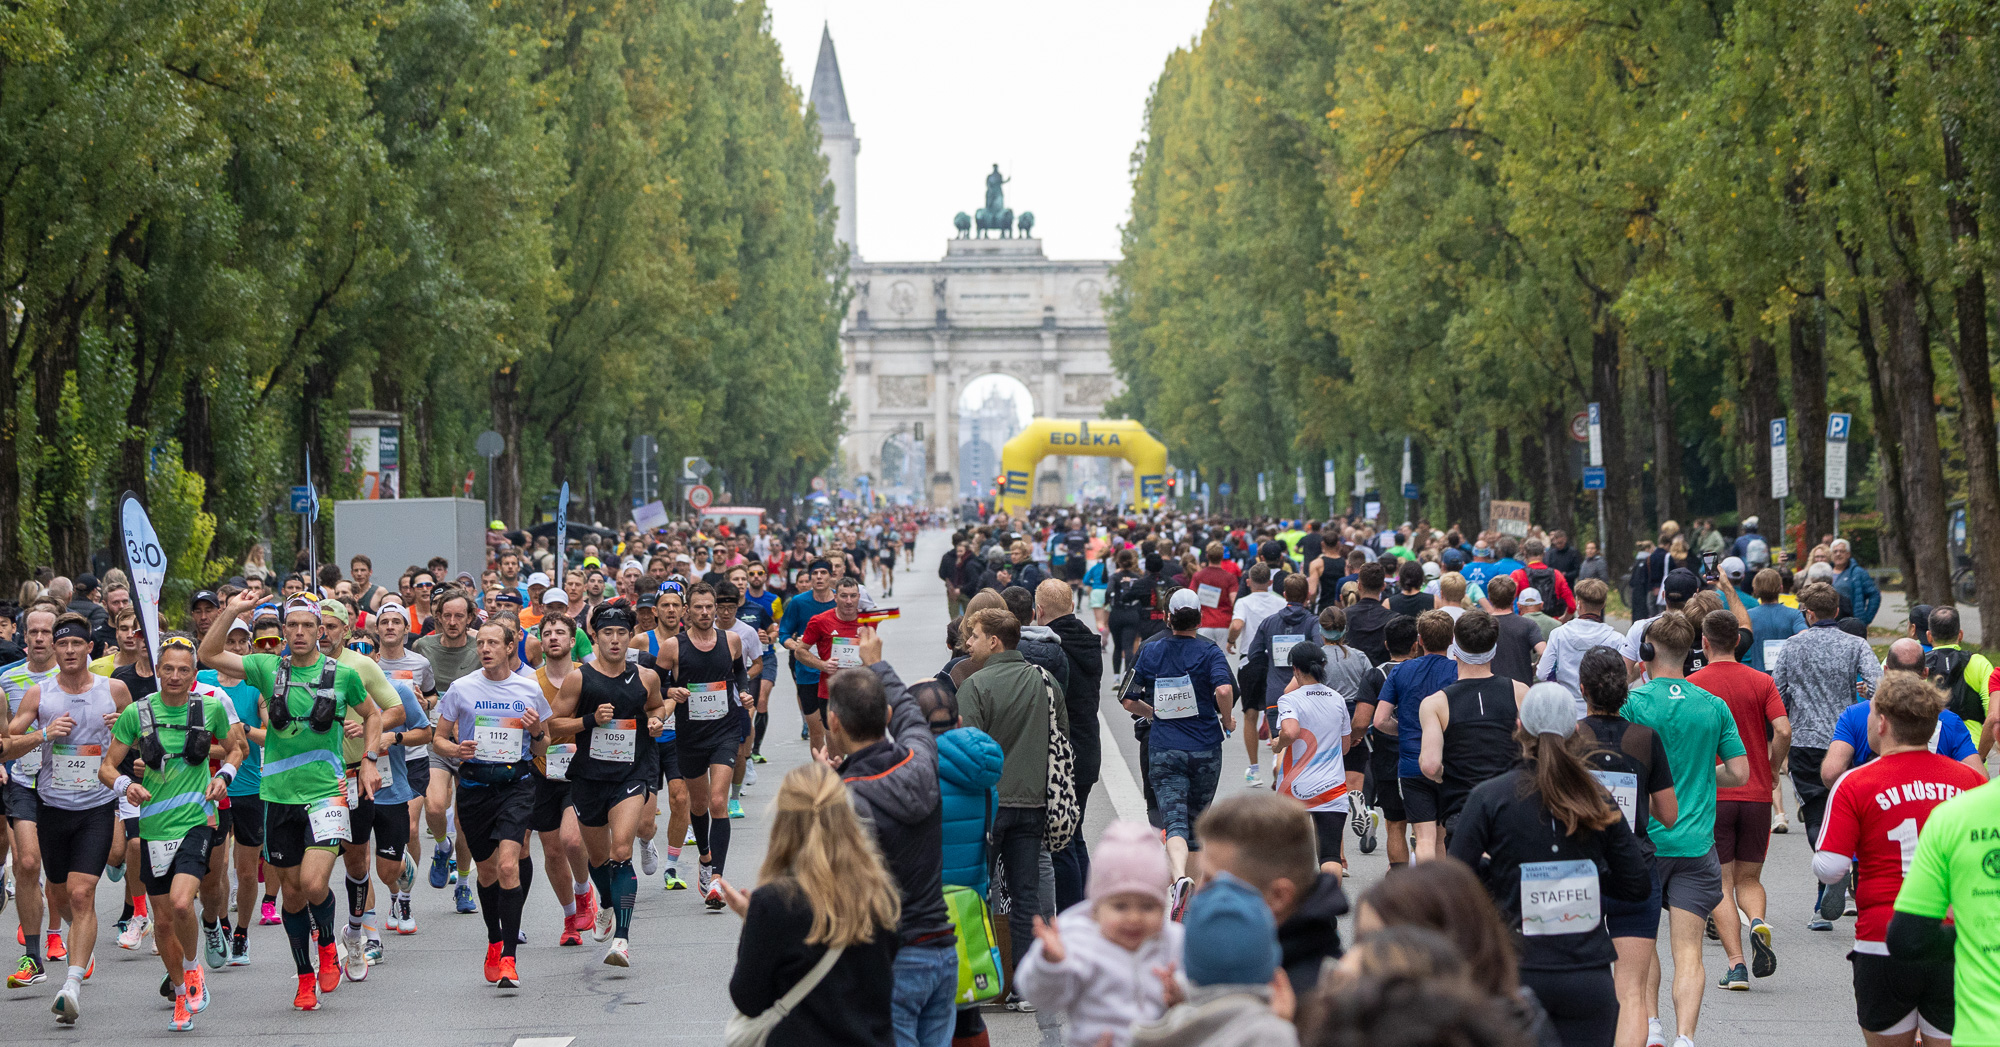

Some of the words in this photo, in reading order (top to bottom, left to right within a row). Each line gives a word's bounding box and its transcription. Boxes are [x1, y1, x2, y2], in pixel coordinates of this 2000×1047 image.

[1830, 417, 1844, 438] P
[1773, 422, 1783, 444] P
[1050, 432, 1121, 446] EDEKA
[128, 539, 162, 568] 3:0
[1158, 691, 1192, 701] STAFFEL
[474, 700, 511, 710] Allianz
[489, 732, 509, 740] 1112
[604, 733, 626, 741] 1059
[67, 760, 86, 769] 242
[1875, 786, 1901, 811] SV
[325, 810, 342, 818] 408
[164, 842, 178, 851] 127
[1530, 888, 1592, 904] STAFFEL
